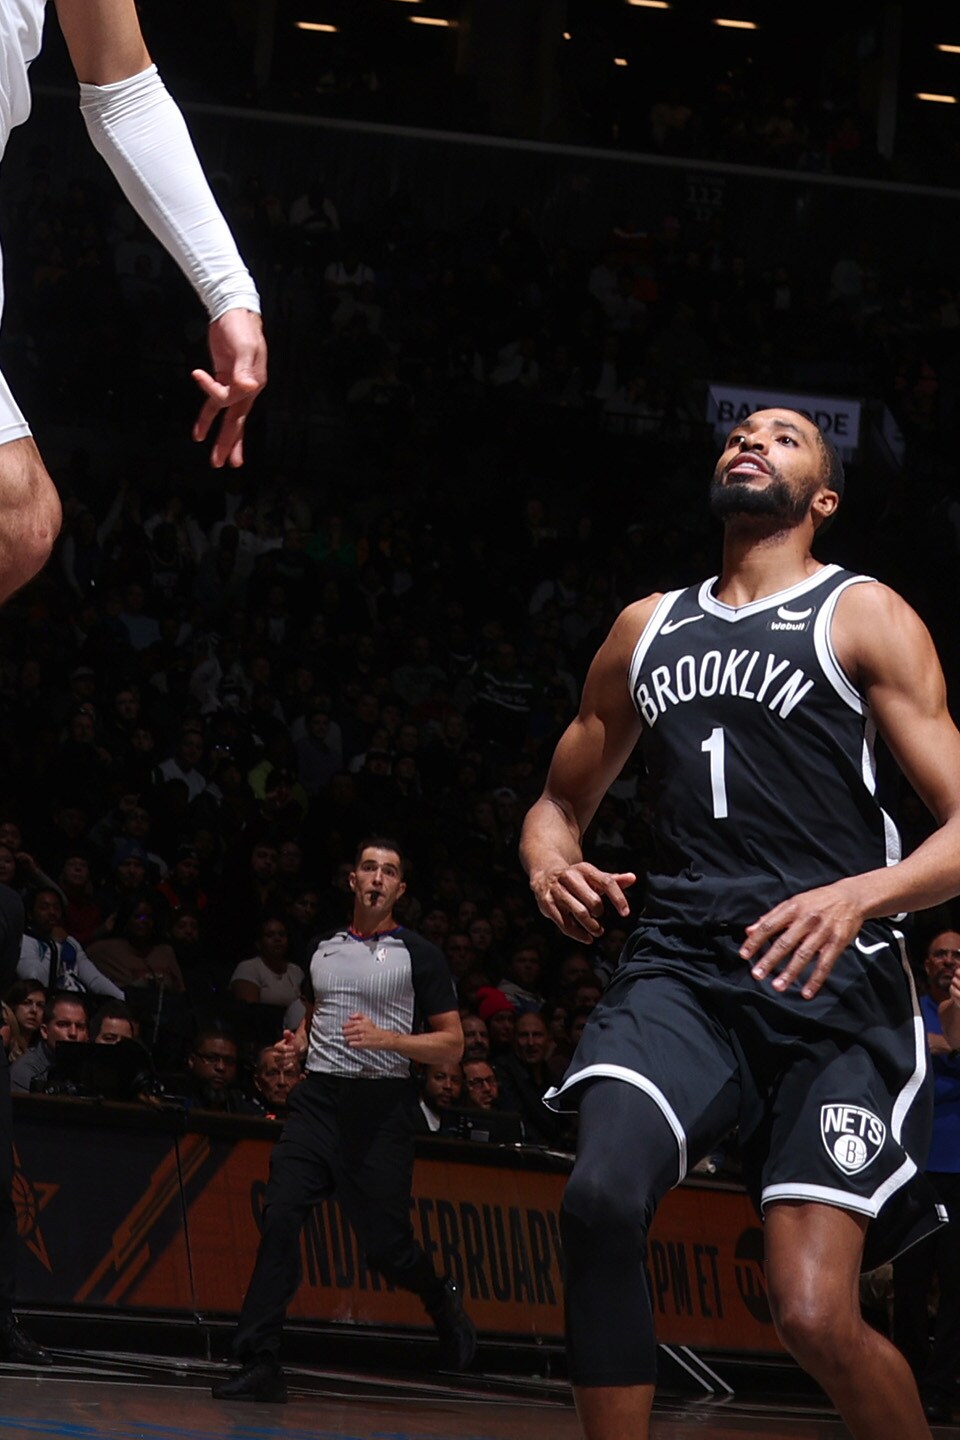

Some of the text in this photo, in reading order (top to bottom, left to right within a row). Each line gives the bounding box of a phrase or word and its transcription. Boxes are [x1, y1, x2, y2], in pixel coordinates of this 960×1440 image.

[717, 400, 849, 436] BADE
[771, 621, 806, 631] Webull
[636, 648, 815, 729] BROOKLYN
[701, 727, 729, 819] 1
[824, 1107, 883, 1146] NETS
[693, 1244, 724, 1319] ET
